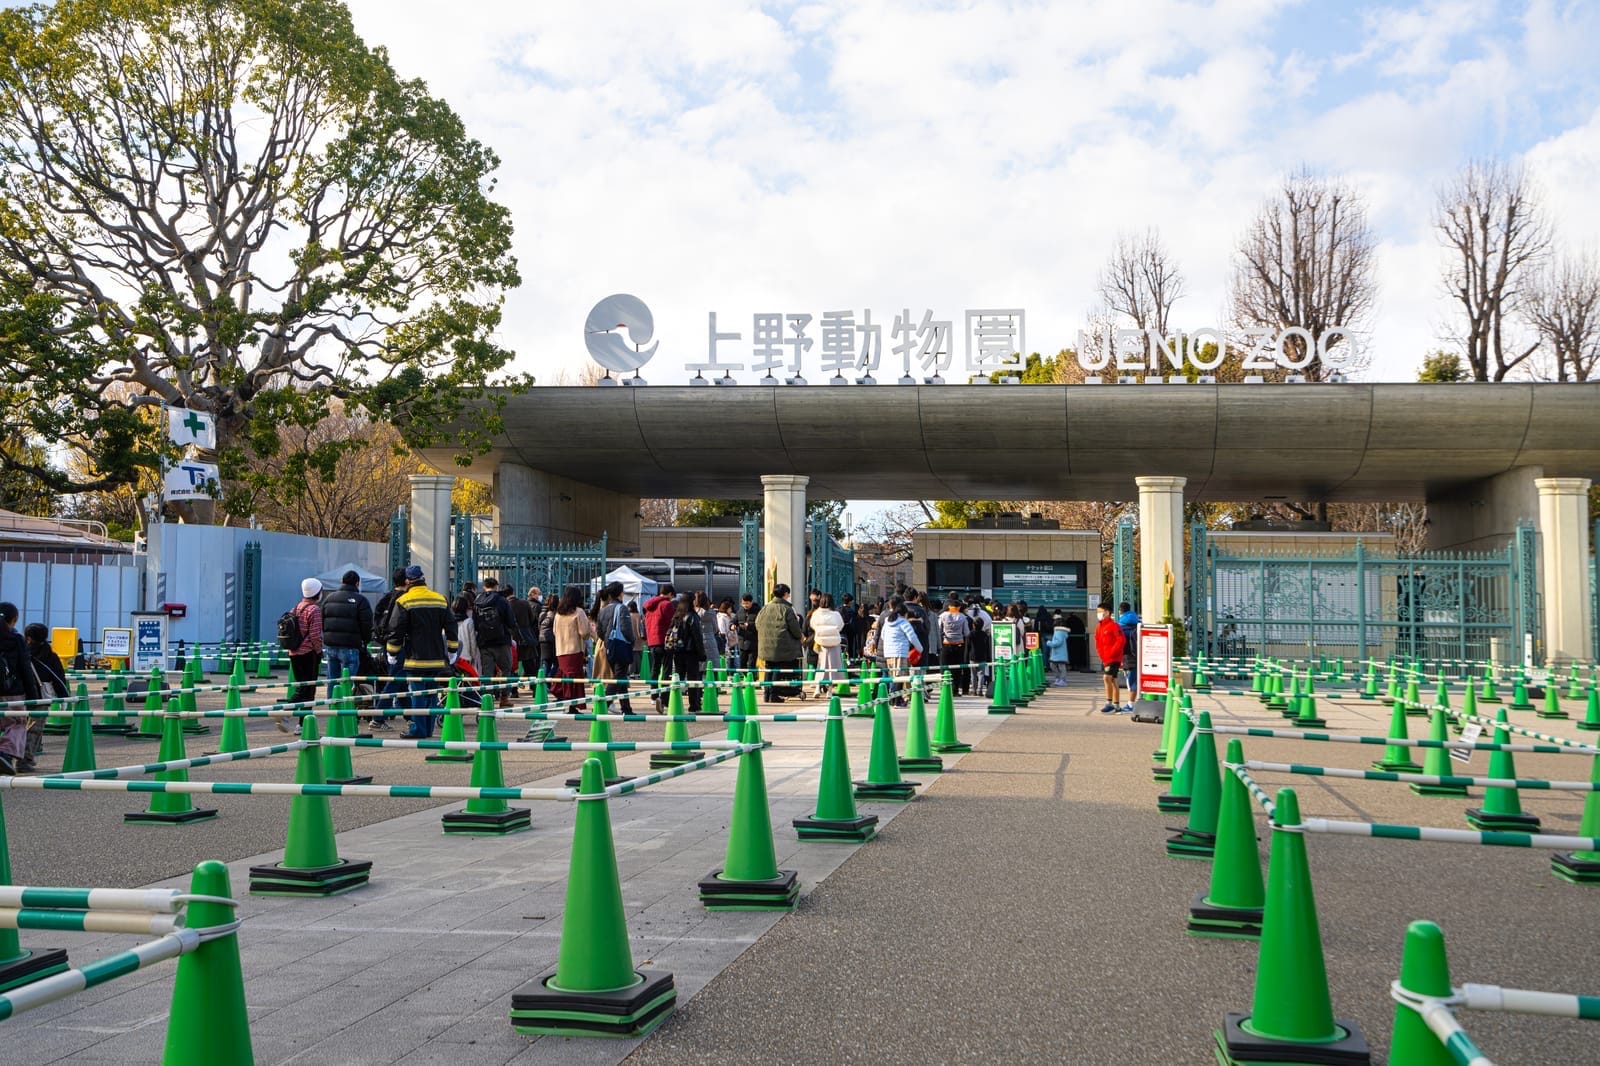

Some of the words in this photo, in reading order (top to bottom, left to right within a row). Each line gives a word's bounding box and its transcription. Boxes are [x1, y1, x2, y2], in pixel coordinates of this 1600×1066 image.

[685, 309, 1026, 373] 上野動物園
[1077, 328, 1226, 371] UENO
[1241, 326, 1357, 370] ZOO
